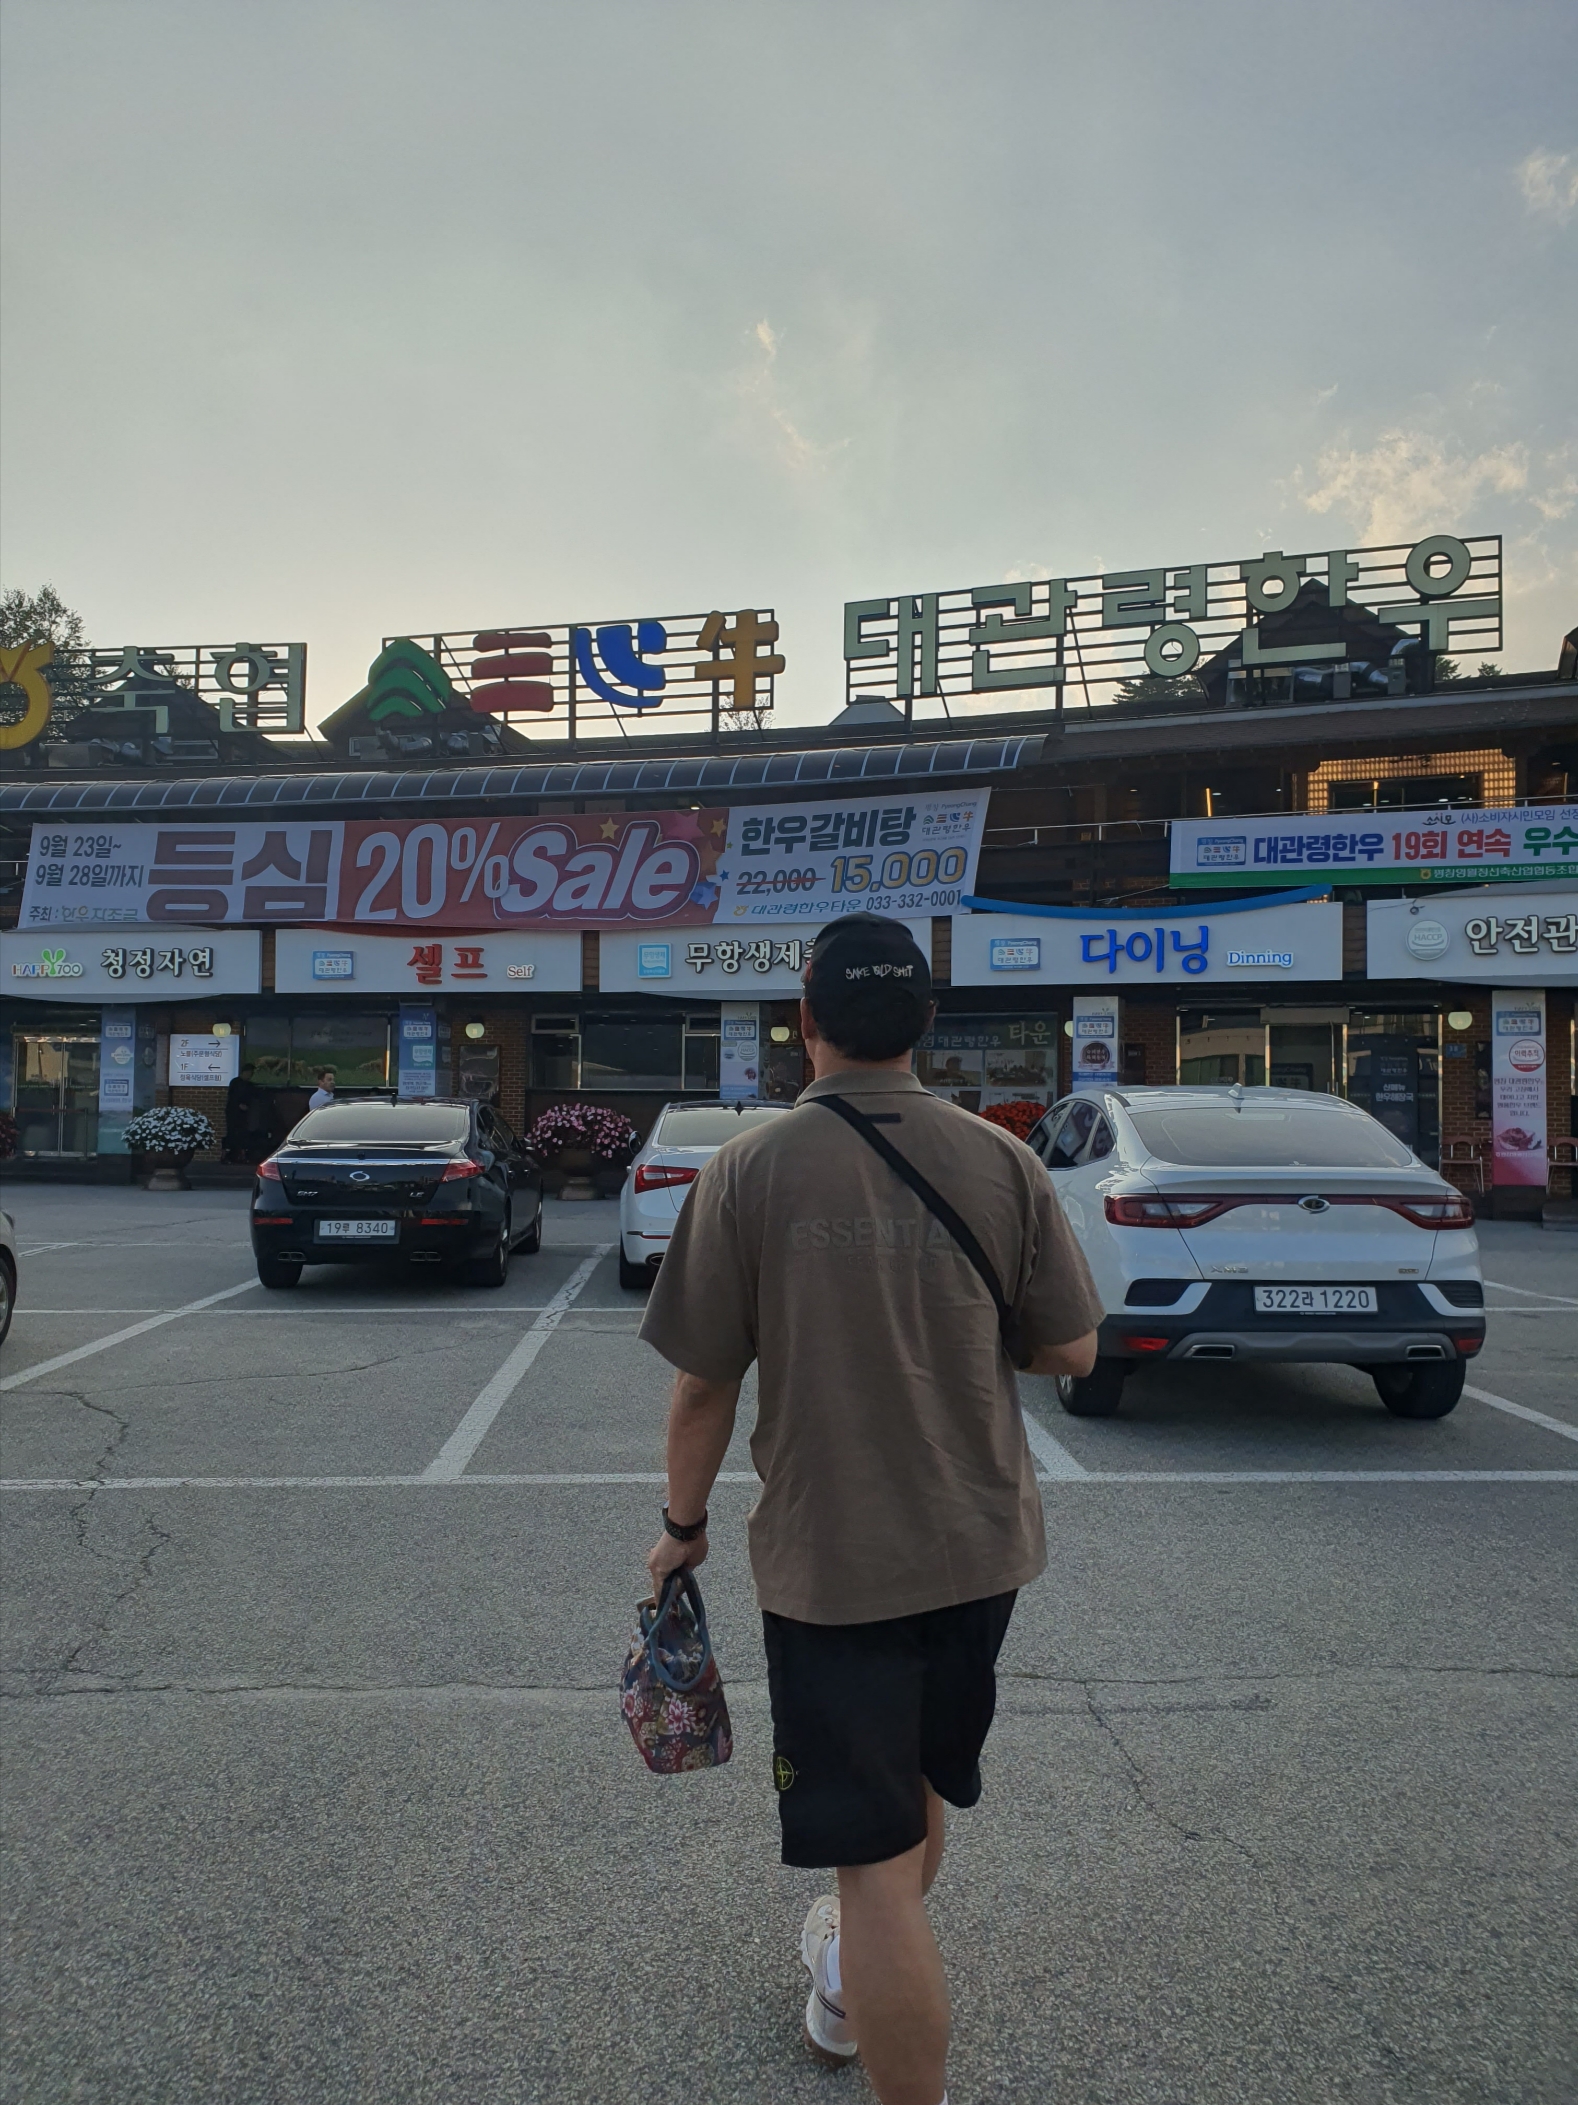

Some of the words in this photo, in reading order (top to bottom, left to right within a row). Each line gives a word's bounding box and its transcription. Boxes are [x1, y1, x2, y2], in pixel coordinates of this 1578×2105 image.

[844, 535, 1502, 696] 대관령한우
[88, 642, 307, 734] 축협
[741, 805, 917, 857] 한우갈비탕
[922, 823, 971, 836] 대관령한우
[1461, 810, 1555, 824] (사)소비자시민모임
[40, 835, 69, 858] 9월
[73, 835, 122, 859] 23일~
[1254, 832, 1384, 864] 대관령한우
[1392, 830, 1448, 861] 19회
[1457, 828, 1512, 859] 연속
[1523, 826, 1578, 857] 우수
[35, 864, 63, 887] 9월
[68, 864, 144, 888] 28일까지
[146, 829, 333, 922] 등심
[354, 821, 509, 920] 20%
[501, 821, 693, 916] Sale
[736, 867, 817, 896] 22,000
[29, 905, 53, 921] 주최
[61, 904, 138, 922] 한우자조금
[751, 898, 863, 916] 대관령한우타운
[865, 889, 962, 911] 033-332-0001
[1079, 925, 1209, 974] 다이닝
[1228, 951, 1293, 967] Dinning
[1414, 932, 1443, 942] HACCP
[100, 947, 214, 979] 청정자연
[406, 943, 488, 985] 셀프
[508, 965, 533, 978] Self
[685, 938, 815, 975] 무항생제
[893, 964, 914, 978] SHIT
[181, 1039, 190, 1047] 2F
[937, 1034, 1001, 1048] 대관령한우
[1008, 1020, 1051, 1046] 타운
[180, 1063, 189, 1071] 1F
[356, 1222, 389, 1234] 8340
[789, 1216, 964, 1250] ESSENTIA
[1262, 1289, 1314, 1308] 322라
[1319, 1289, 1370, 1308] 1220
